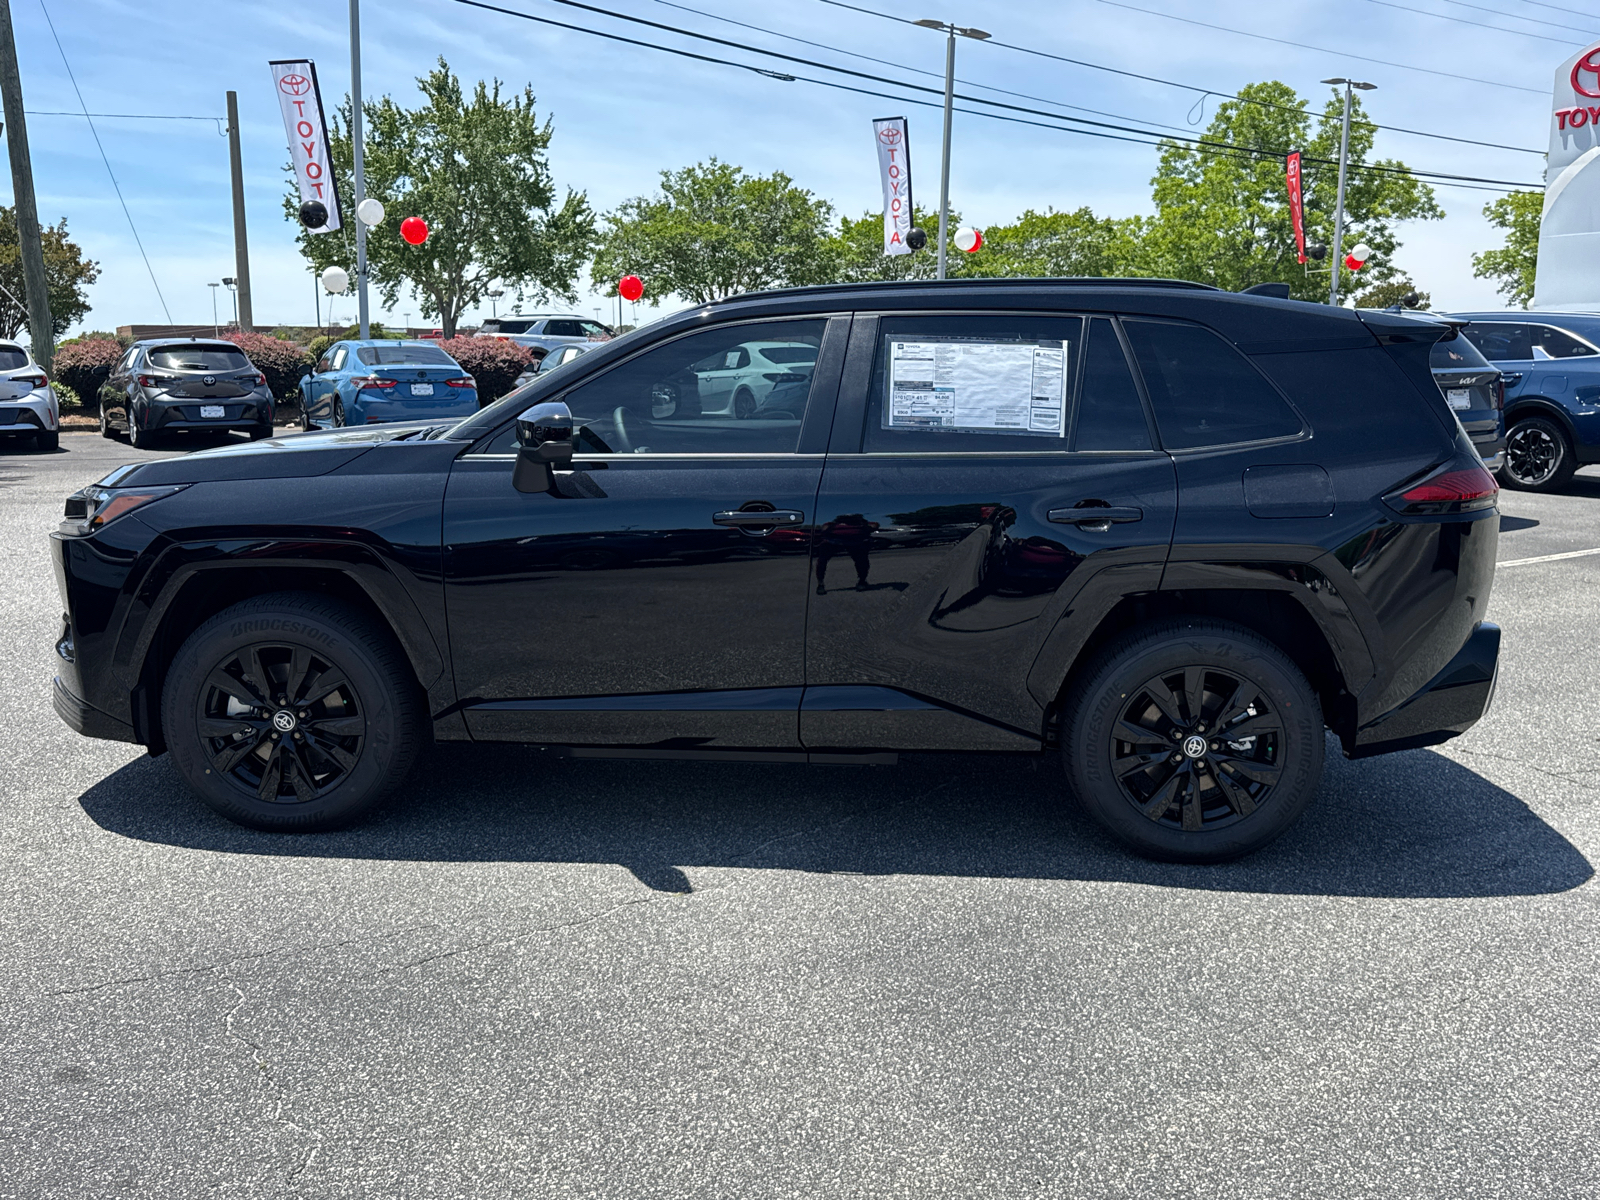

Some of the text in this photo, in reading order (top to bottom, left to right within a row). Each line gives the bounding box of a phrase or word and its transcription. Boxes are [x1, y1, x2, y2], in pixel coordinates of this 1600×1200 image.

[292, 100, 323, 199] TOYOT
[887, 148, 901, 244] TOYOTA
[231, 618, 339, 648] BRIDGESTONE
[1087, 680, 1123, 783] BRIDGESTONE
[1275, 718, 1313, 821] BRIDGESTONE
[219, 798, 327, 827] BRIDGESTONE
